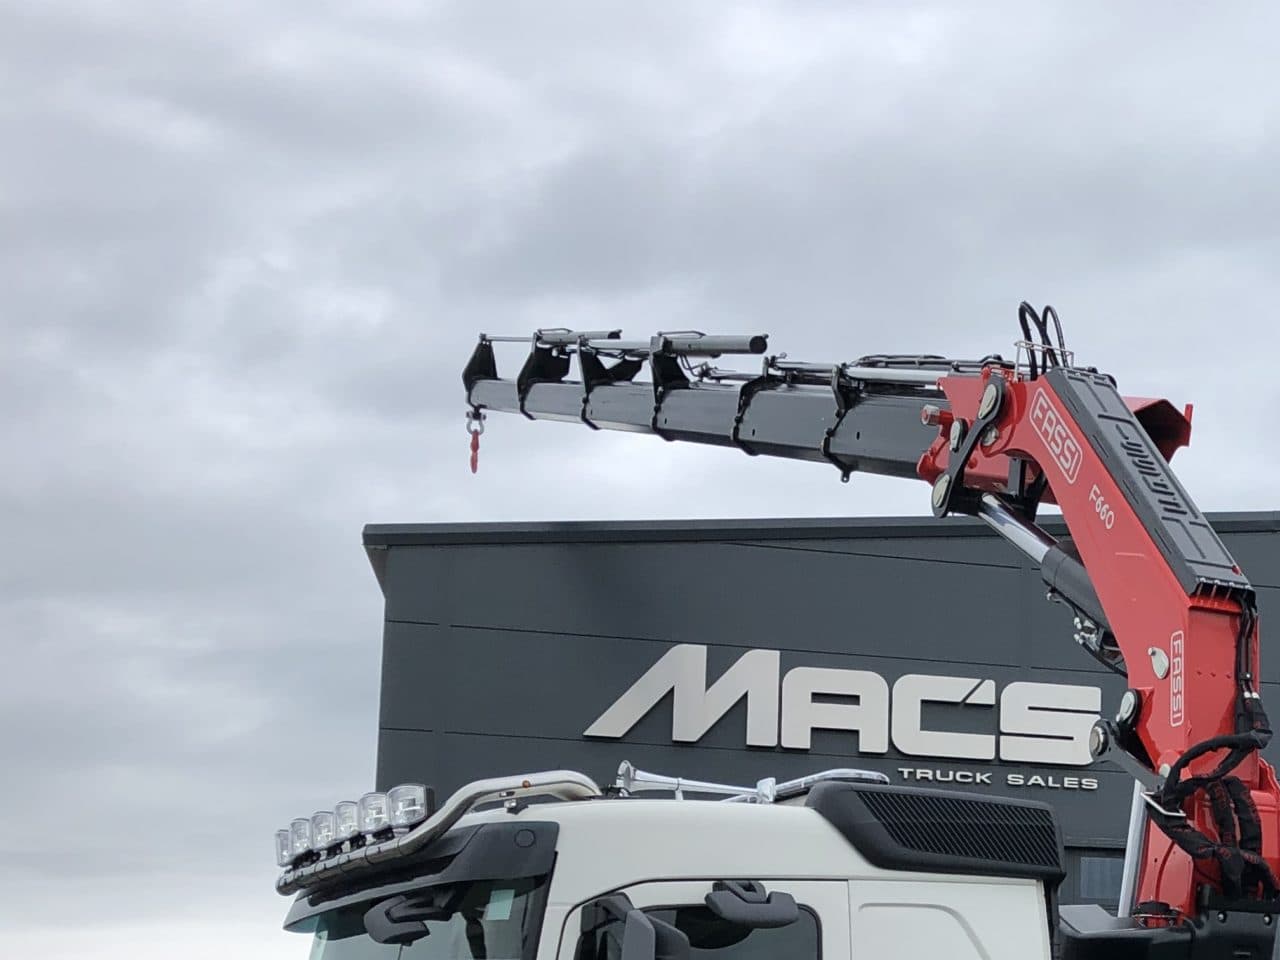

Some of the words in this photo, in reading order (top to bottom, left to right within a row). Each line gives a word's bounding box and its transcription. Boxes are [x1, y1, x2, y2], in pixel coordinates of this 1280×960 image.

[1033, 395, 1079, 476] FASSI
[1088, 484, 1115, 530] F660
[897, 767, 993, 785] TRUCK
[1006, 773, 1098, 790] SALES
